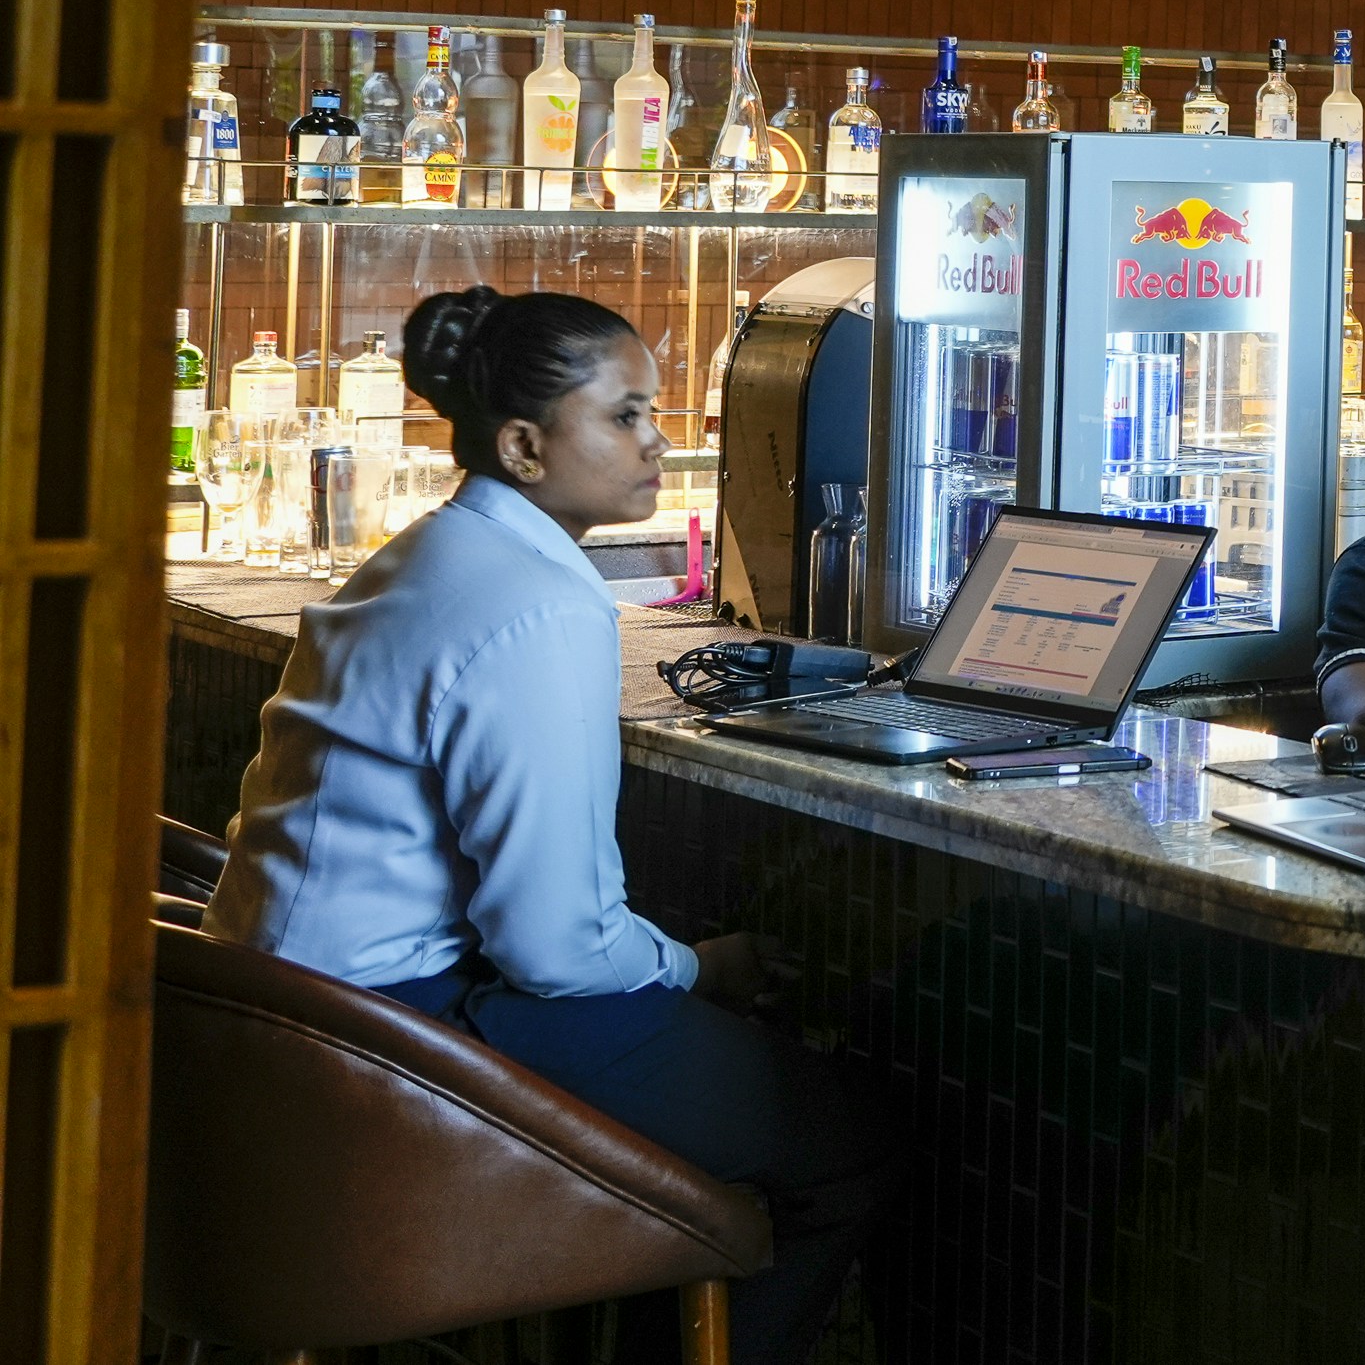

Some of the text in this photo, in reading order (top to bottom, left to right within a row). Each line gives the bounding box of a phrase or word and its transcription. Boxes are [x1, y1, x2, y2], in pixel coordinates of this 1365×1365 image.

[216, 128, 235, 140] 1800
[937, 252, 1023, 296] Red Bull
[1115, 257, 1263, 300] Red Bull
